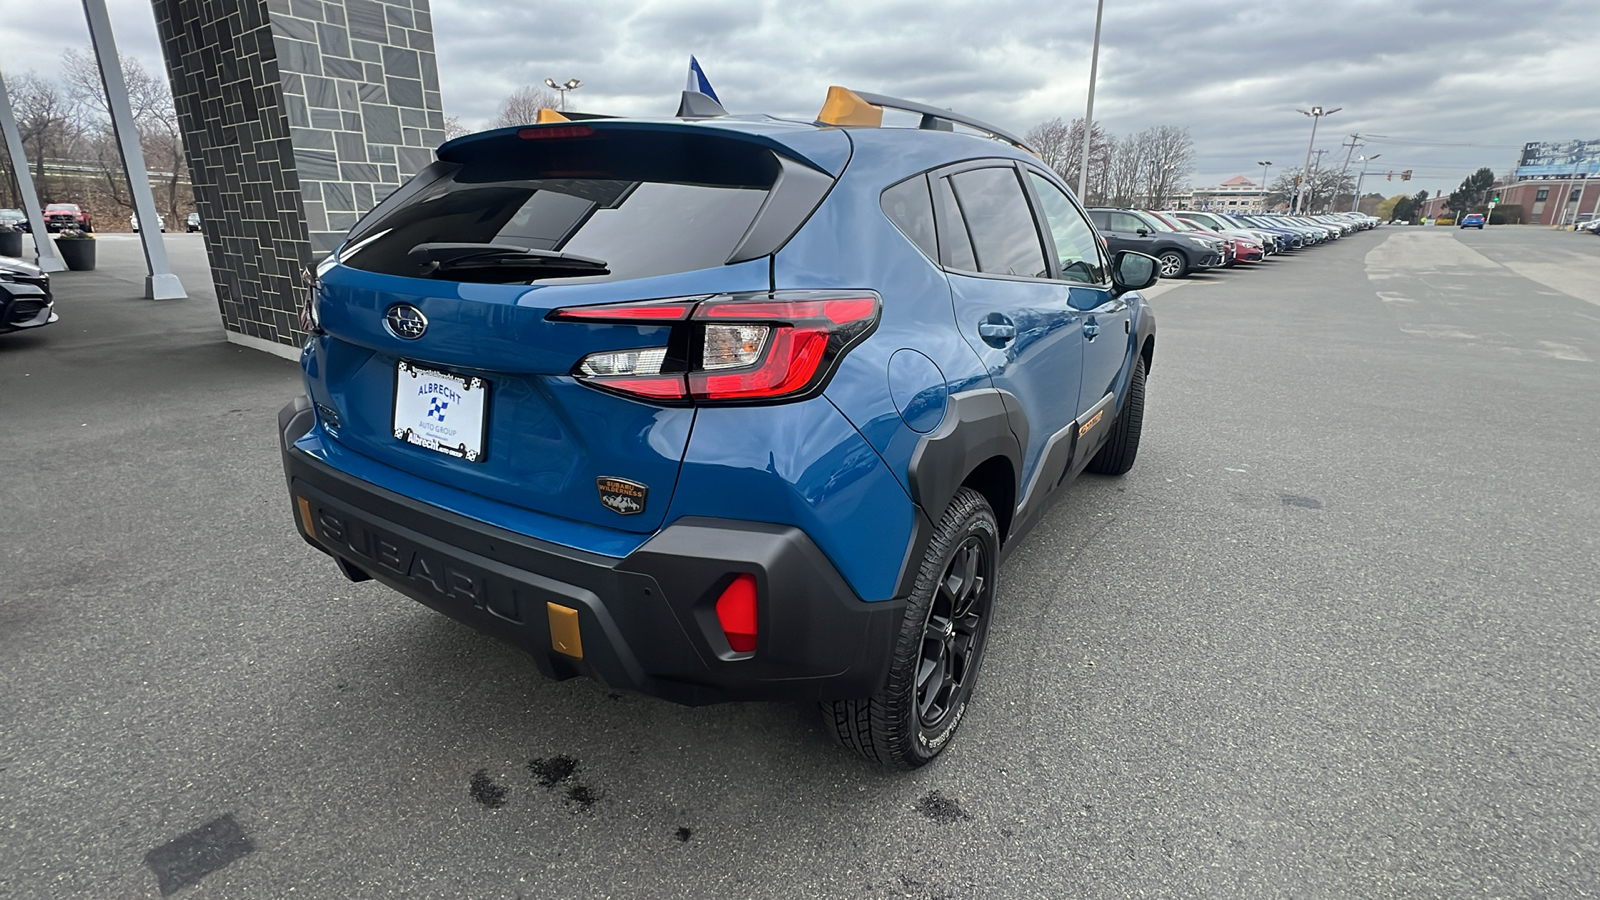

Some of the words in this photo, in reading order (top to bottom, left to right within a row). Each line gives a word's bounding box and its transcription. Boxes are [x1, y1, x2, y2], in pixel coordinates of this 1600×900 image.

[418, 383, 462, 405] ALBRECHT
[419, 421, 434, 431] AUTO
[435, 425, 457, 436] GROUP
[407, 433, 440, 451] Albrecht
[599, 485, 643, 497] WILDERNESS
[606, 481, 635, 490] SUBARU
[318, 507, 526, 626] SUBARU
